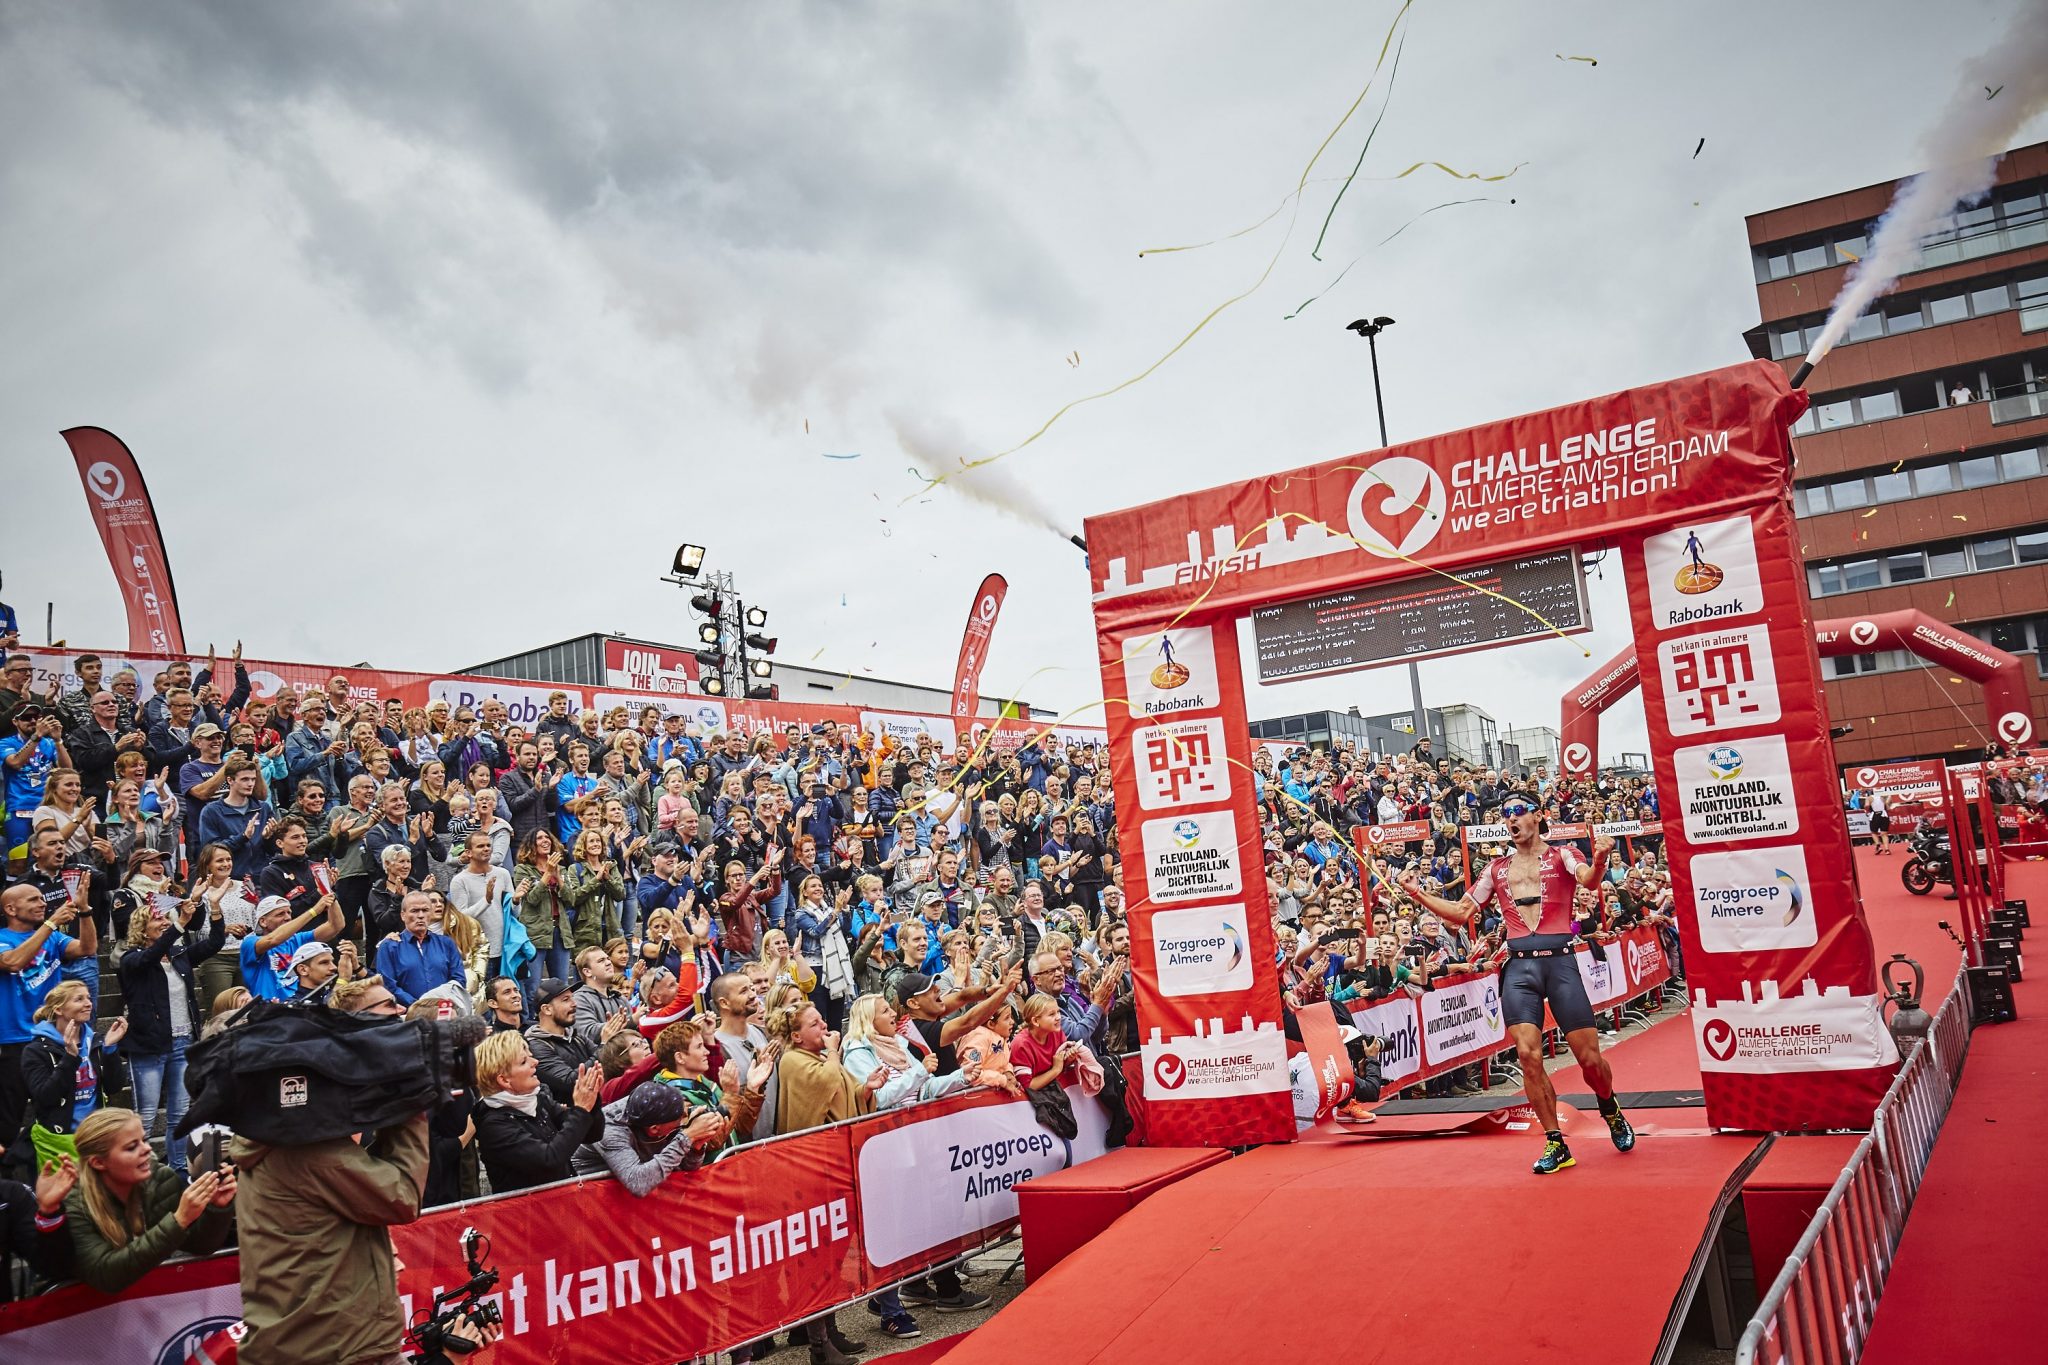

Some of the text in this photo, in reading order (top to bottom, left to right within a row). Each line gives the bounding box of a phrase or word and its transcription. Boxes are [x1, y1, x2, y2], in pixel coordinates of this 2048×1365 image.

[1452, 418, 1656, 488] CHALLENGE
[1452, 431, 1728, 512] ALMERE-AMSTERDAM
[1451, 466, 1678, 534] we are triathlon!
[1174, 553, 1261, 585] FINISH
[1669, 598, 1743, 625] Rabobank
[1671, 633, 1748, 654] het kan in almere
[1915, 625, 2002, 668] CHALLENGEFAMILY
[622, 649, 660, 677] JOIN
[631, 673, 652, 690] THE
[1145, 694, 1204, 713] Rabobank
[1180, 724, 1208, 735] almere
[1879, 766, 1920, 777] CHALLENGE
[1695, 780, 1770, 800] FLEVOLAND.
[1690, 792, 1783, 815] AVONTUURLIJK
[1706, 809, 1766, 827] DICHTBIJ.
[1601, 823, 1640, 834] Rabobank
[1693, 821, 1788, 839] www.ookflevoland.nl
[1160, 848, 1221, 864] FLEVOLAND.
[1154, 859, 1230, 877] AVONTUURLIJK
[1168, 874, 1217, 888] DICHTBIJ.
[1700, 885, 1779, 904] Zorggroep
[1711, 904, 1764, 918] Almere
[1159, 937, 1225, 952] Zorggroep
[1169, 953, 1213, 965] Almere
[1738, 1024, 1821, 1038] CHALLENGE
[1738, 1034, 1852, 1048] ALMERE-AMSTERDAM
[1773, 1045, 1831, 1057] triathlon!
[1187, 1055, 1253, 1069] CHALLENGE
[1188, 1062, 1275, 1077] ALMERE-AMSTERDAM
[1215, 1072, 1259, 1083] triathlon!
[948, 1132, 1053, 1172] Zorggroep
[965, 1167, 1033, 1202] Almere
[545, 1258, 640, 1327] kan
[652, 1237, 696, 1300] in
[710, 1198, 849, 1284] almere
